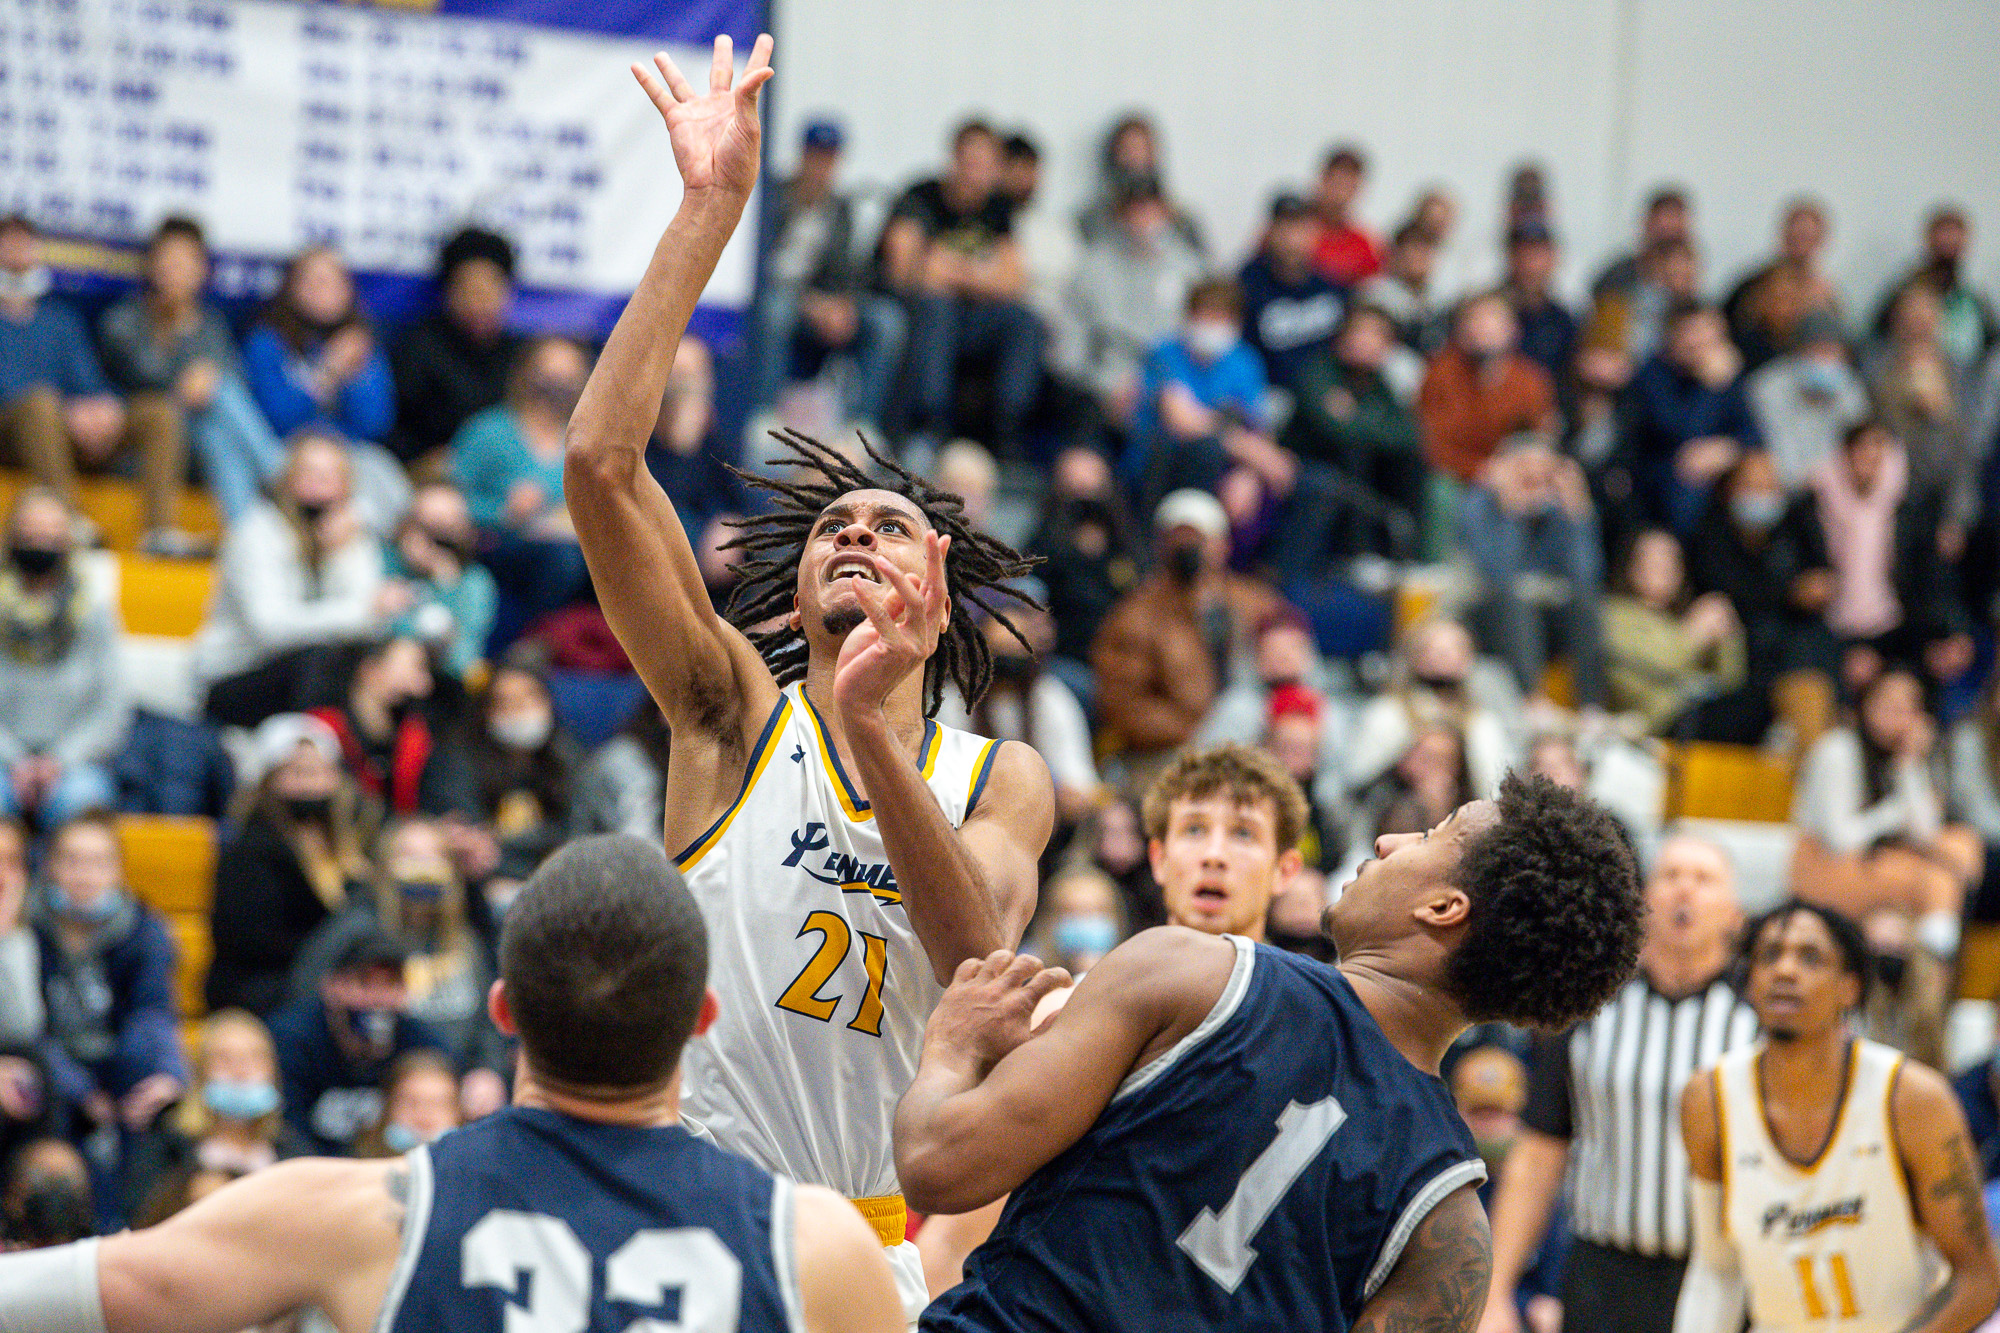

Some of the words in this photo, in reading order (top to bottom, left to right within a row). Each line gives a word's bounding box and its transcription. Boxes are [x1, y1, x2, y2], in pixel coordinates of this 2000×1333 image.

[774, 909, 888, 1038] 21
[1175, 1095, 1348, 1295] 1
[1794, 1253, 1860, 1320] 11
